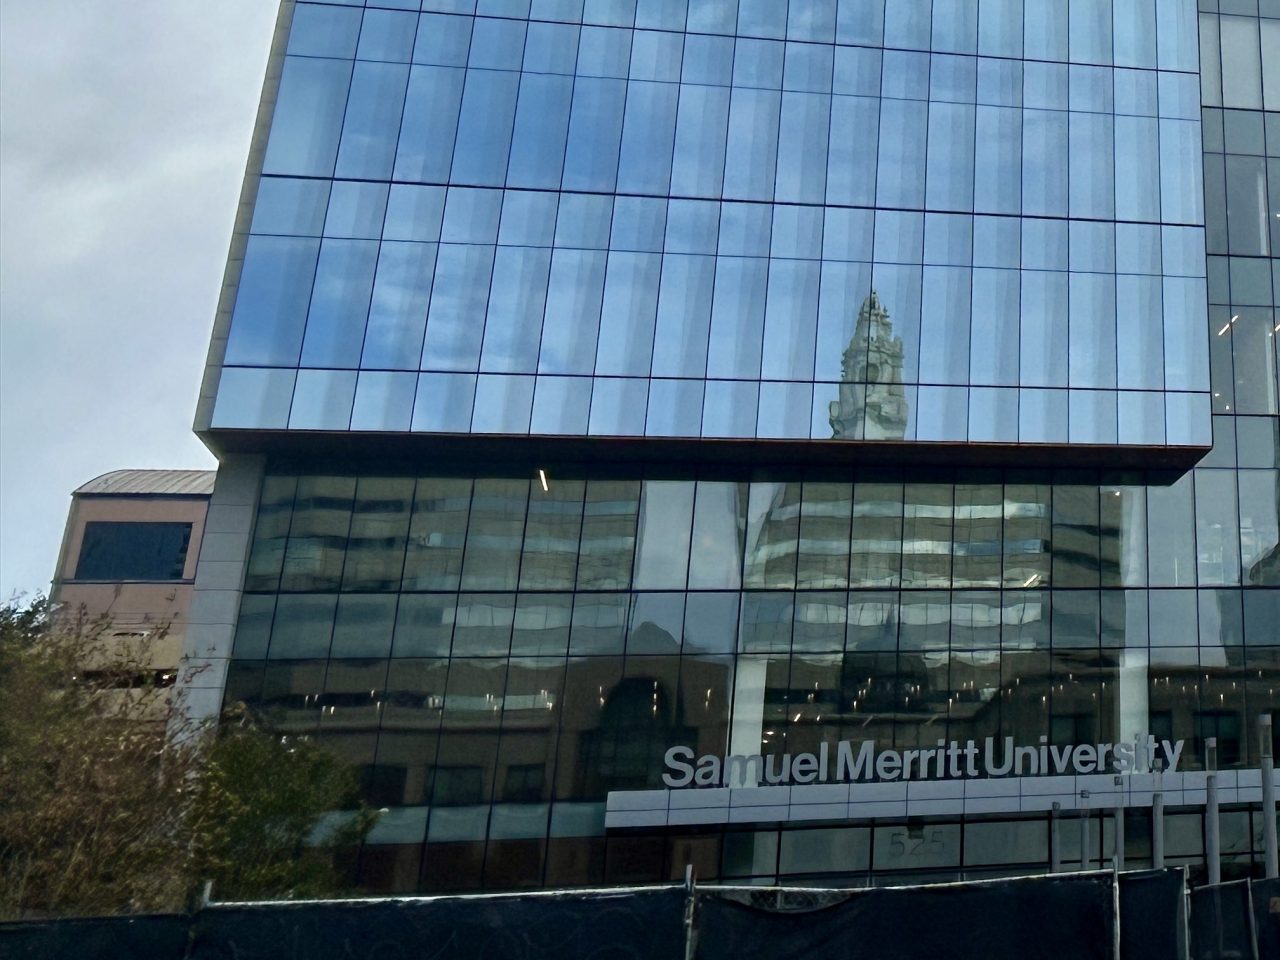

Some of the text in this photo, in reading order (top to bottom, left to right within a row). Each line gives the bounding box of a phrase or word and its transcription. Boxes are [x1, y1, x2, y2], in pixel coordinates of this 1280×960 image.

[661, 733, 1185, 789] Samuel Merritt University
